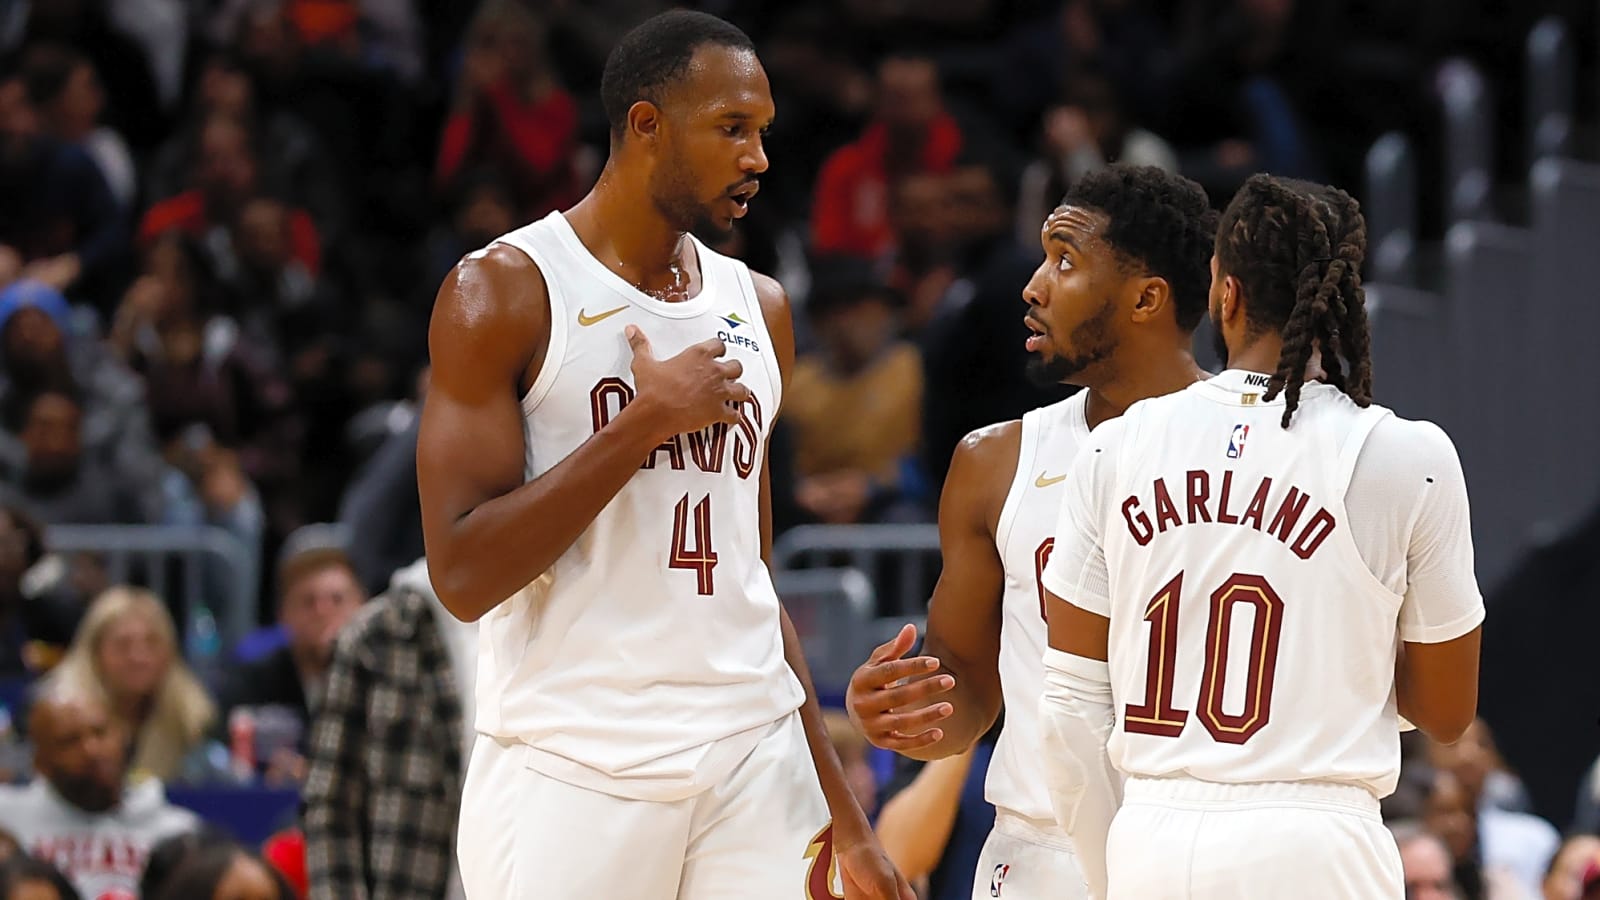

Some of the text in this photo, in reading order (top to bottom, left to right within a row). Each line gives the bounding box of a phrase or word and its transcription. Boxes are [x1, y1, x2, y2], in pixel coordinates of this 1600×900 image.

[717, 330, 760, 352] CLIFFS
[1244, 374, 1271, 388] NIK
[668, 491, 718, 596] 4
[1121, 469, 1336, 560] GARLAND
[1123, 569, 1285, 745] 10
